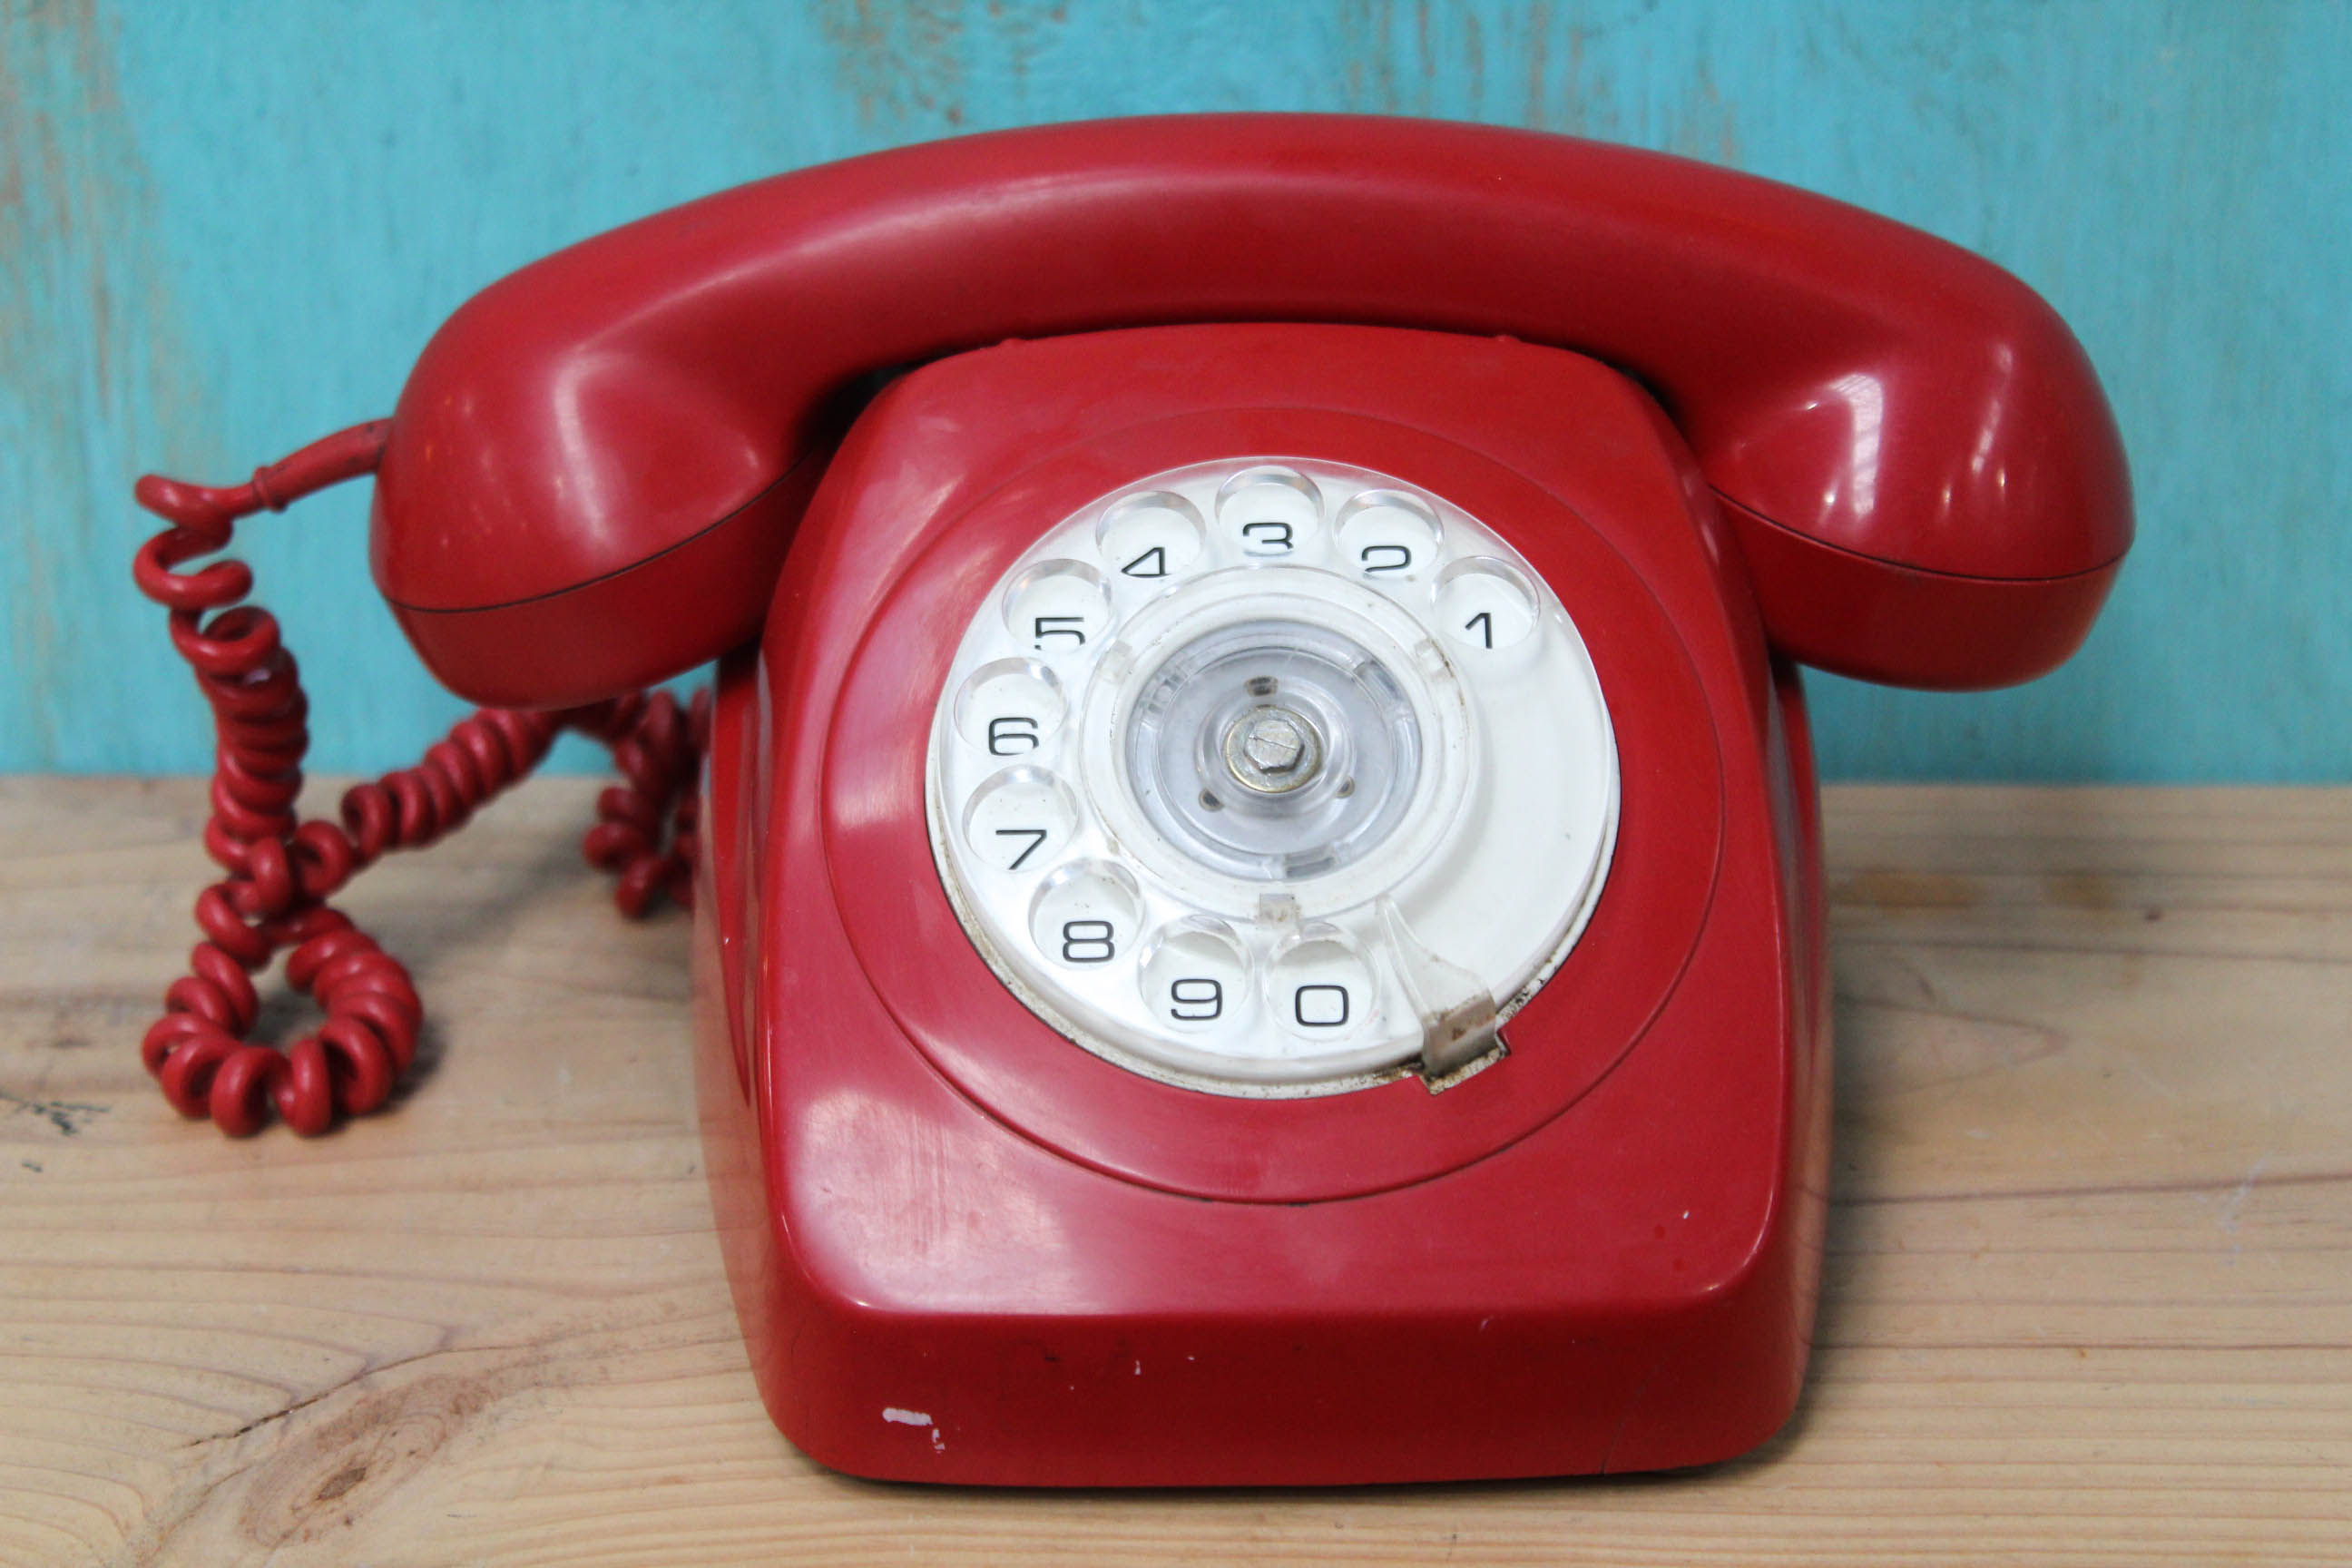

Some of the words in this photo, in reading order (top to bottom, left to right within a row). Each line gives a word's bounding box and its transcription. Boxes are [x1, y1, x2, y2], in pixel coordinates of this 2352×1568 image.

[1242, 522, 1294, 554] 3
[1121, 546, 1169, 579] 4
[1361, 544, 1412, 574] 2
[1034, 616, 1086, 649] 5
[1465, 612, 1493, 650] 1
[987, 716, 1040, 757] 6
[995, 828, 1047, 870] 7
[1062, 920, 1115, 964] 8
[1170, 978, 1223, 1022] 9
[1294, 985, 1350, 1027] 0
